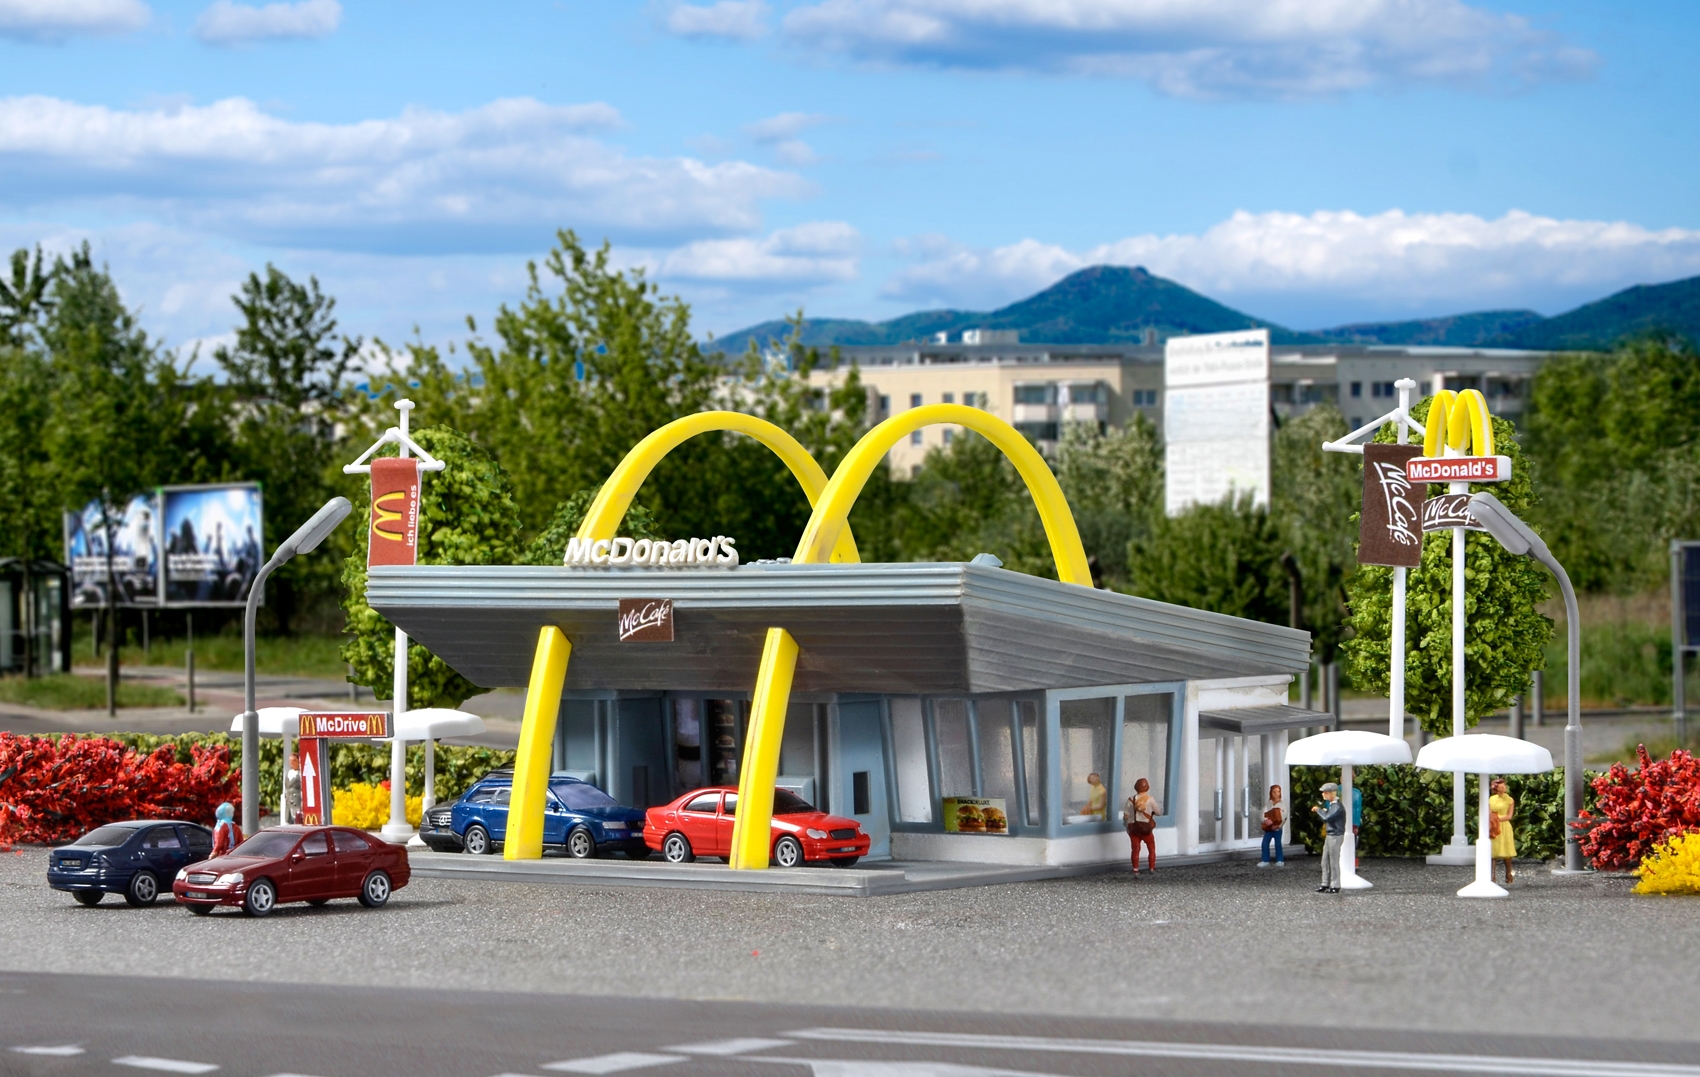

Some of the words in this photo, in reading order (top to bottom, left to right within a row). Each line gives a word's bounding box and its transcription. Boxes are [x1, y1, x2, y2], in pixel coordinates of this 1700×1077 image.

[1409, 461, 1494, 479] McDonald's
[410, 484, 417, 499] es
[408, 500, 417, 528] liebe
[1375, 461, 1419, 546] McCafé
[406, 529, 415, 547] ich
[563, 535, 740, 567] McDonald's
[619, 598, 671, 638] McCafé
[316, 717, 367, 732] McDrive
